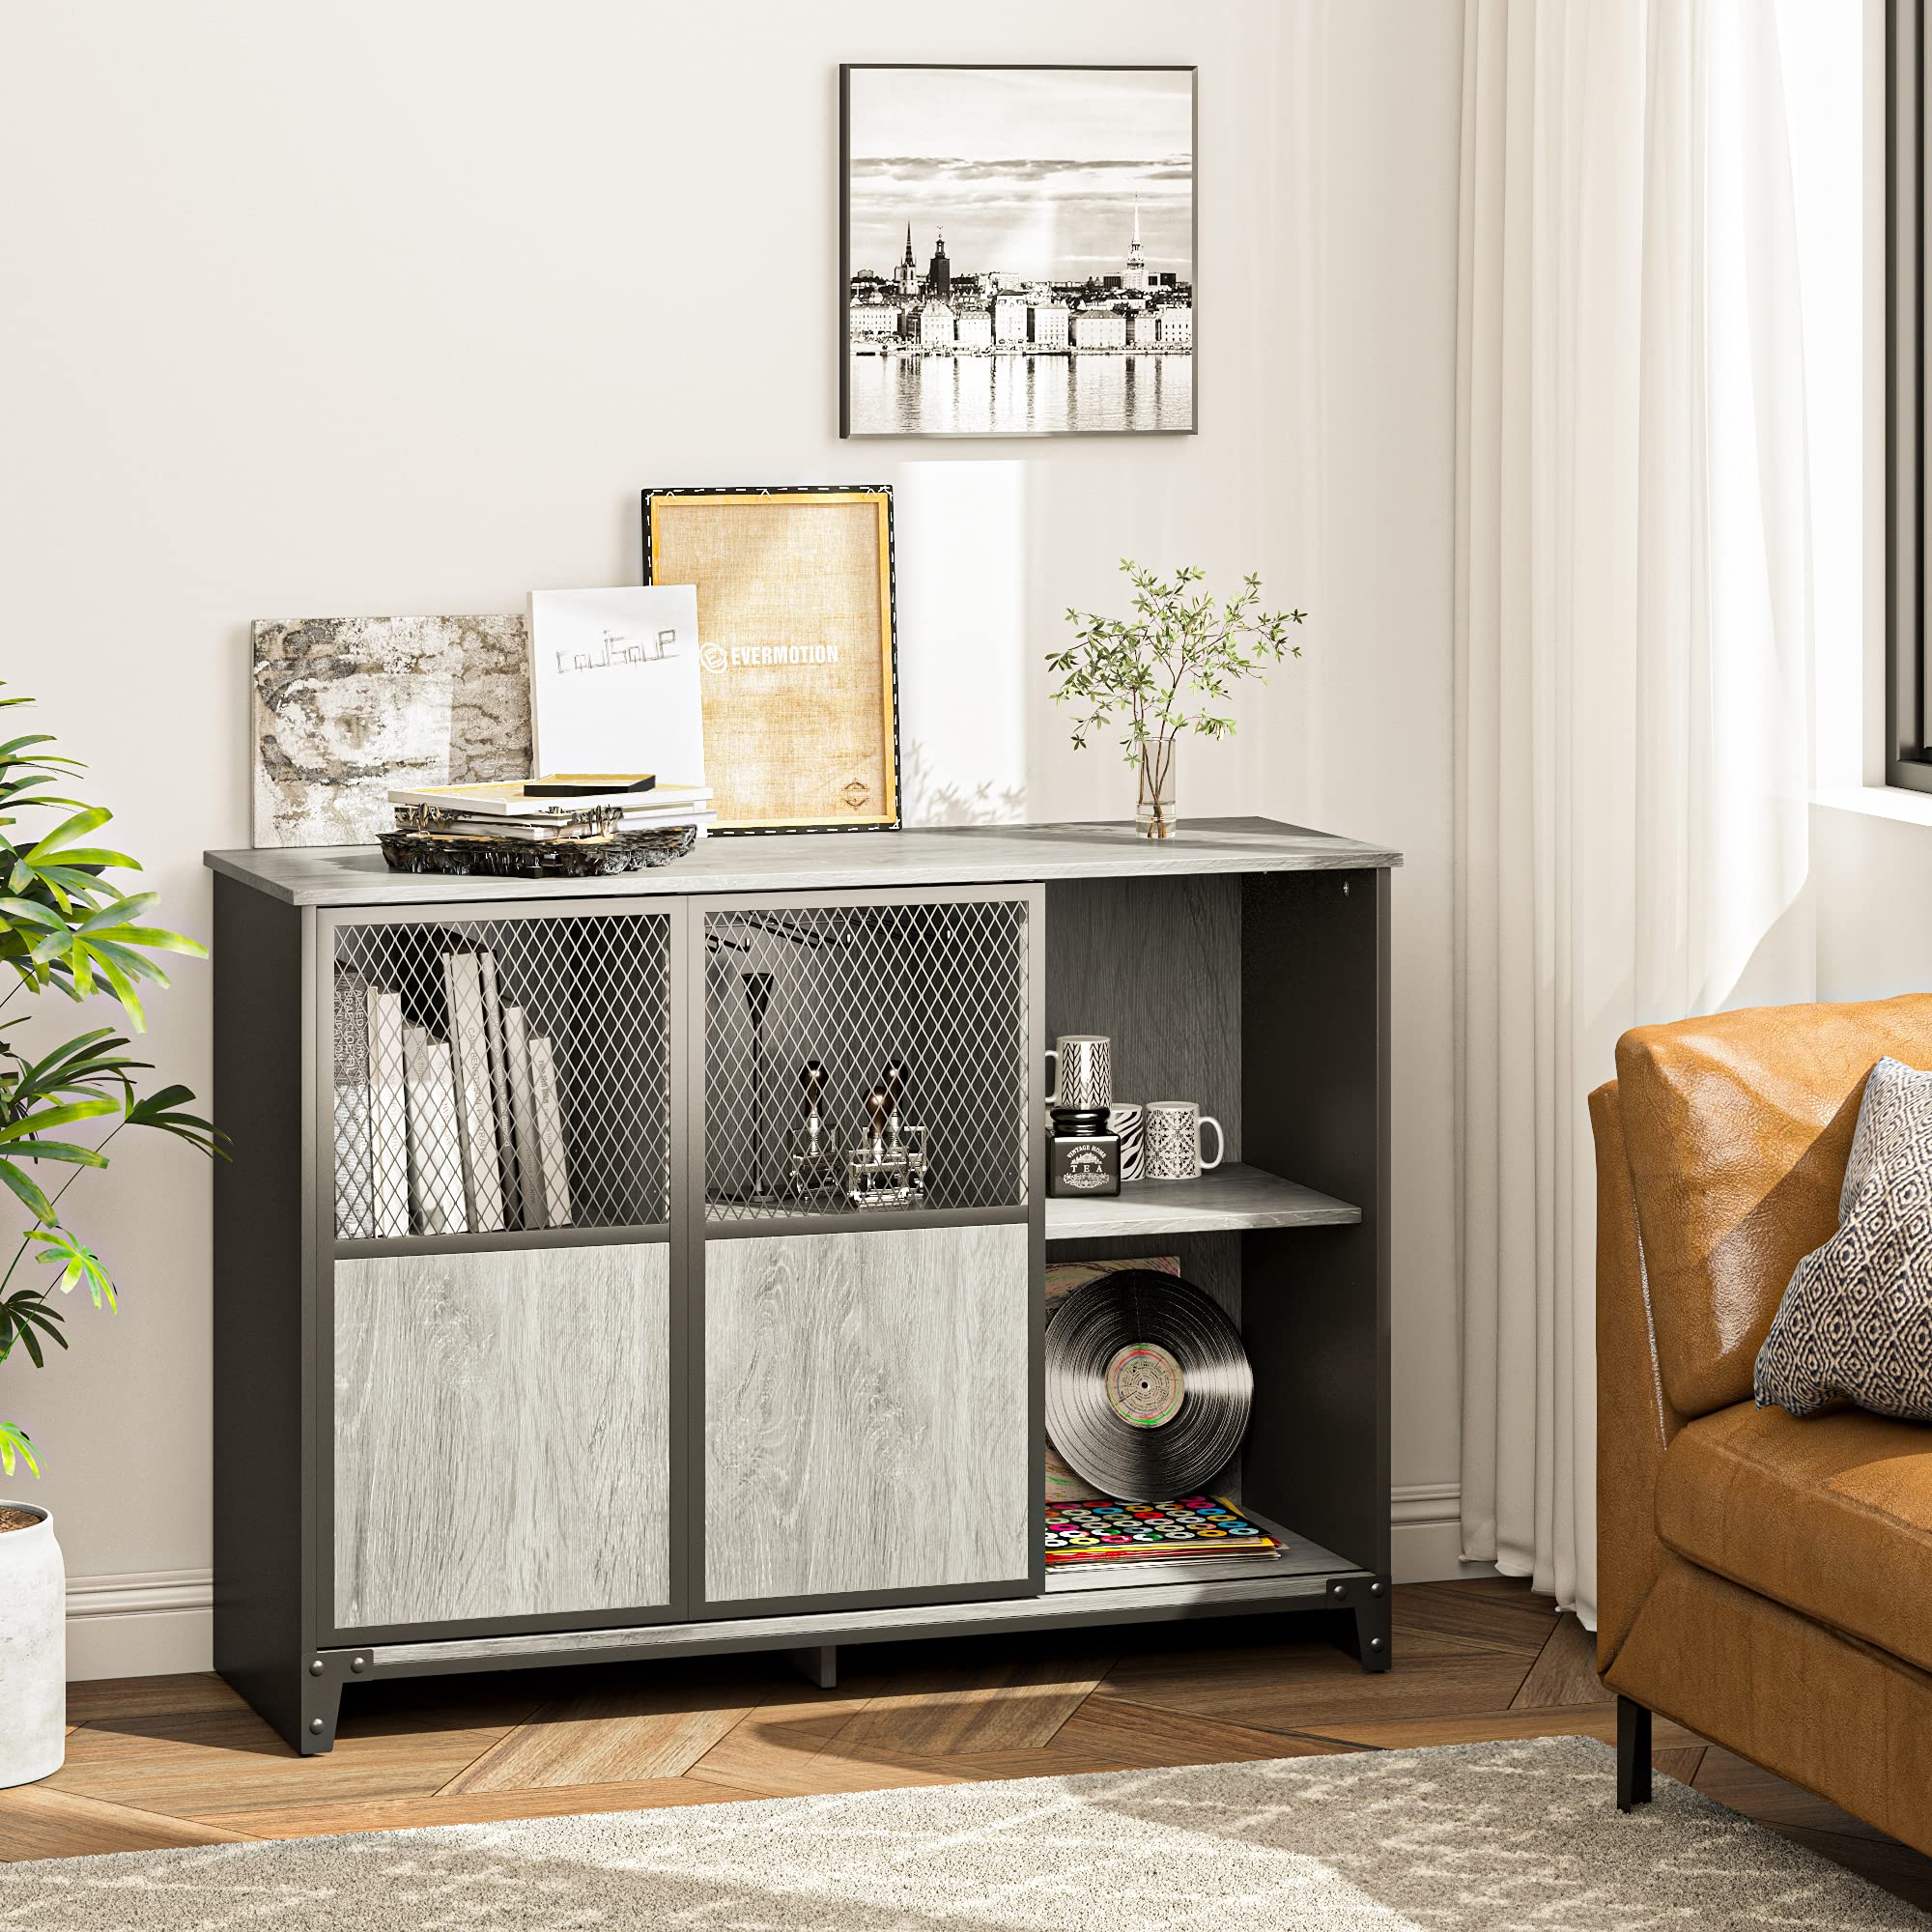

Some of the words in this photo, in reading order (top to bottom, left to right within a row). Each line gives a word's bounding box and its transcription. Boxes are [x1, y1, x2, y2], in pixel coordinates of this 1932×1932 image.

[731, 645, 838, 666] EVERMOTION
[1066, 1145, 1091, 1159] VINTAGE
[1091, 1145, 1107, 1159] HOME
